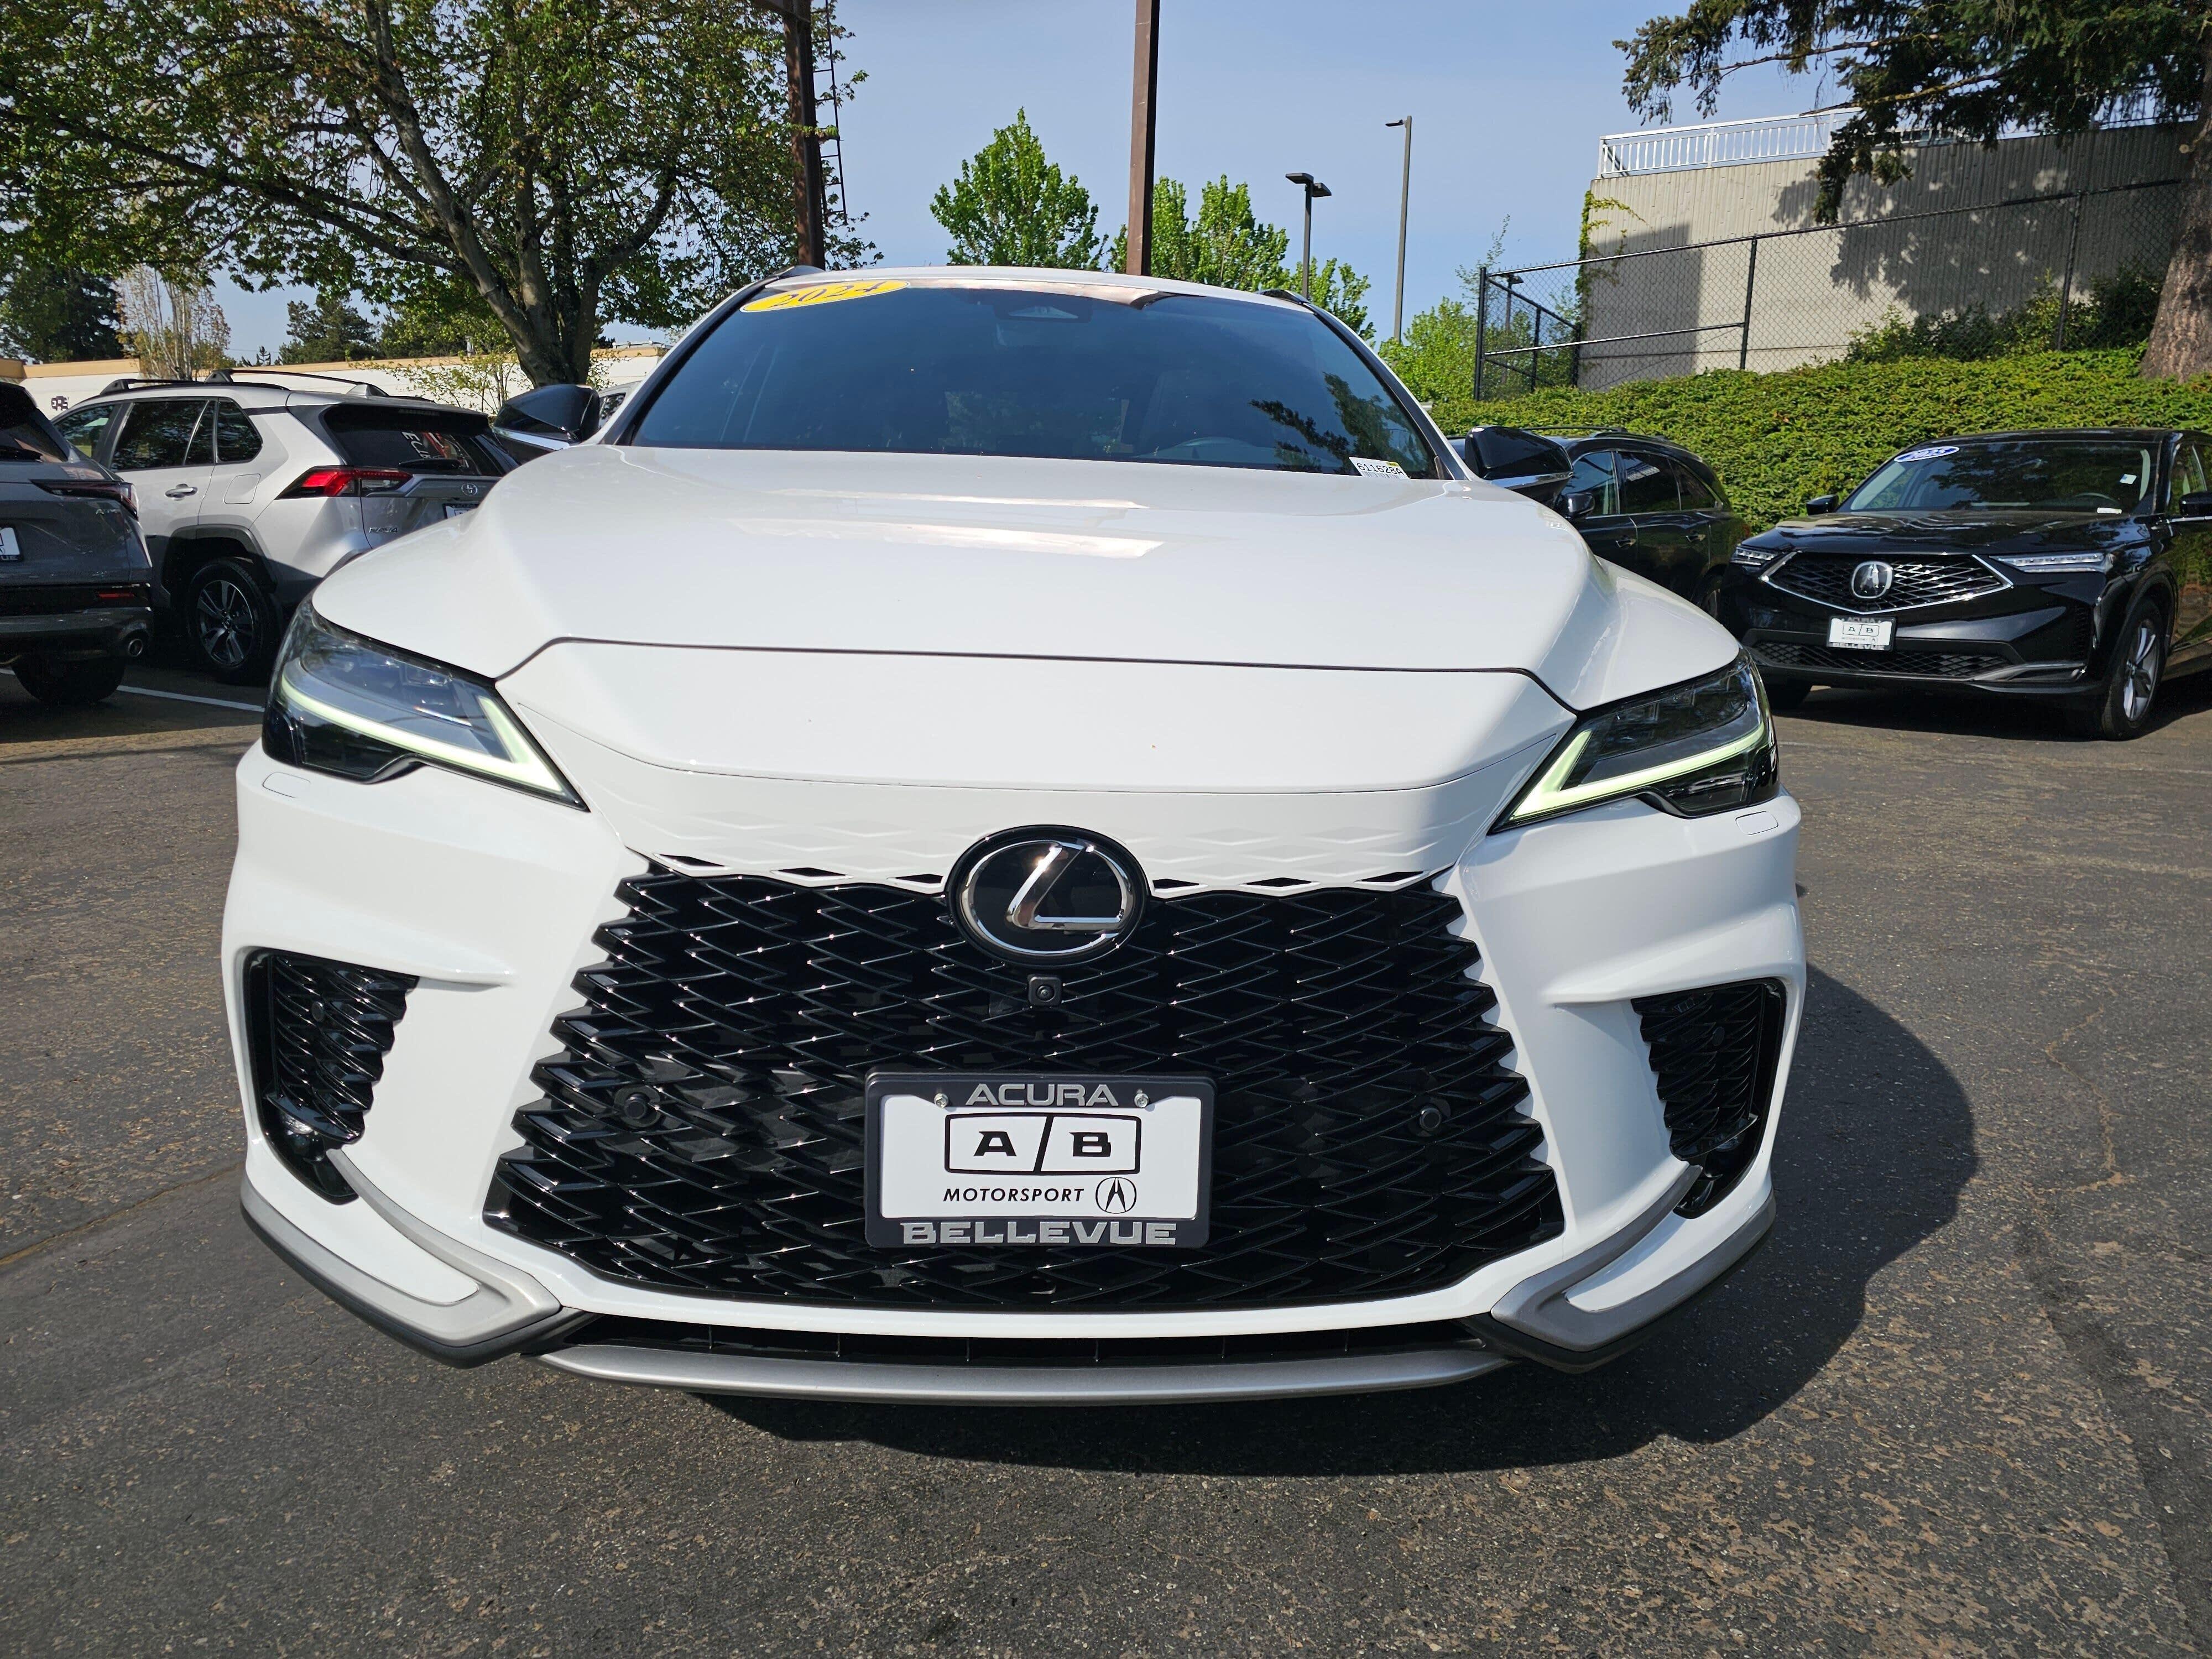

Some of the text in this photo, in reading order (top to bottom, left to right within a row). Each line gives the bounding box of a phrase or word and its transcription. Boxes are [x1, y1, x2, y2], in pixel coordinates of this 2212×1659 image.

[769, 280, 888, 308] 2024
[1356, 462, 1405, 476] 611628A
[965, 1083, 1119, 1107] ACURA
[973, 1131, 1112, 1157] A B
[943, 1187, 1084, 1203] MOTORSPORT
[900, 1221, 1177, 1245] BELLEVUE
